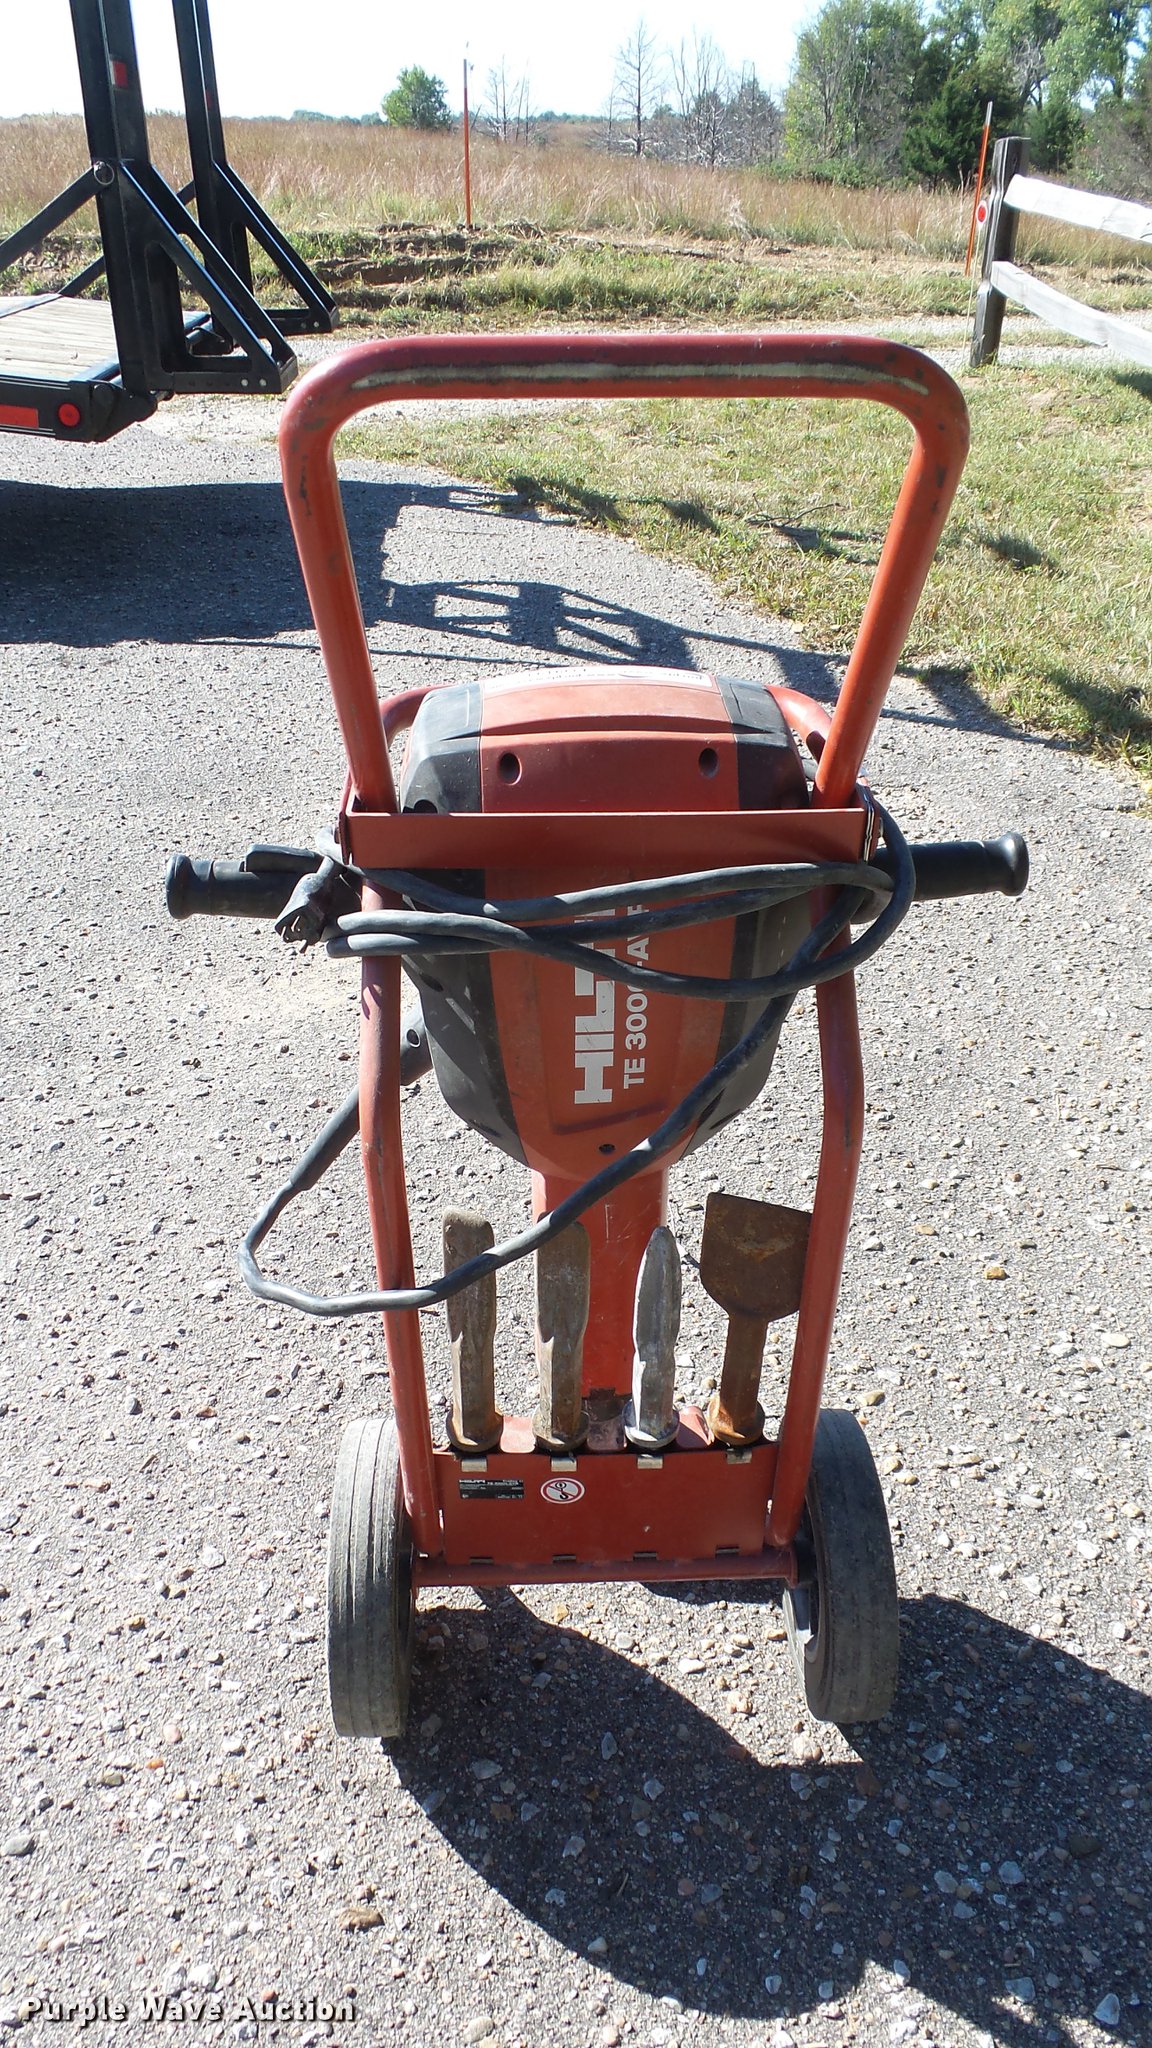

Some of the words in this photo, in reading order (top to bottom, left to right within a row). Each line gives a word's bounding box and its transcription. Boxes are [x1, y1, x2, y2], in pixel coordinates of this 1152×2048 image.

[574, 907, 616, 1104] HIL
[625, 903, 649, 1050] 300-A
[624, 1057, 646, 1089] TE
